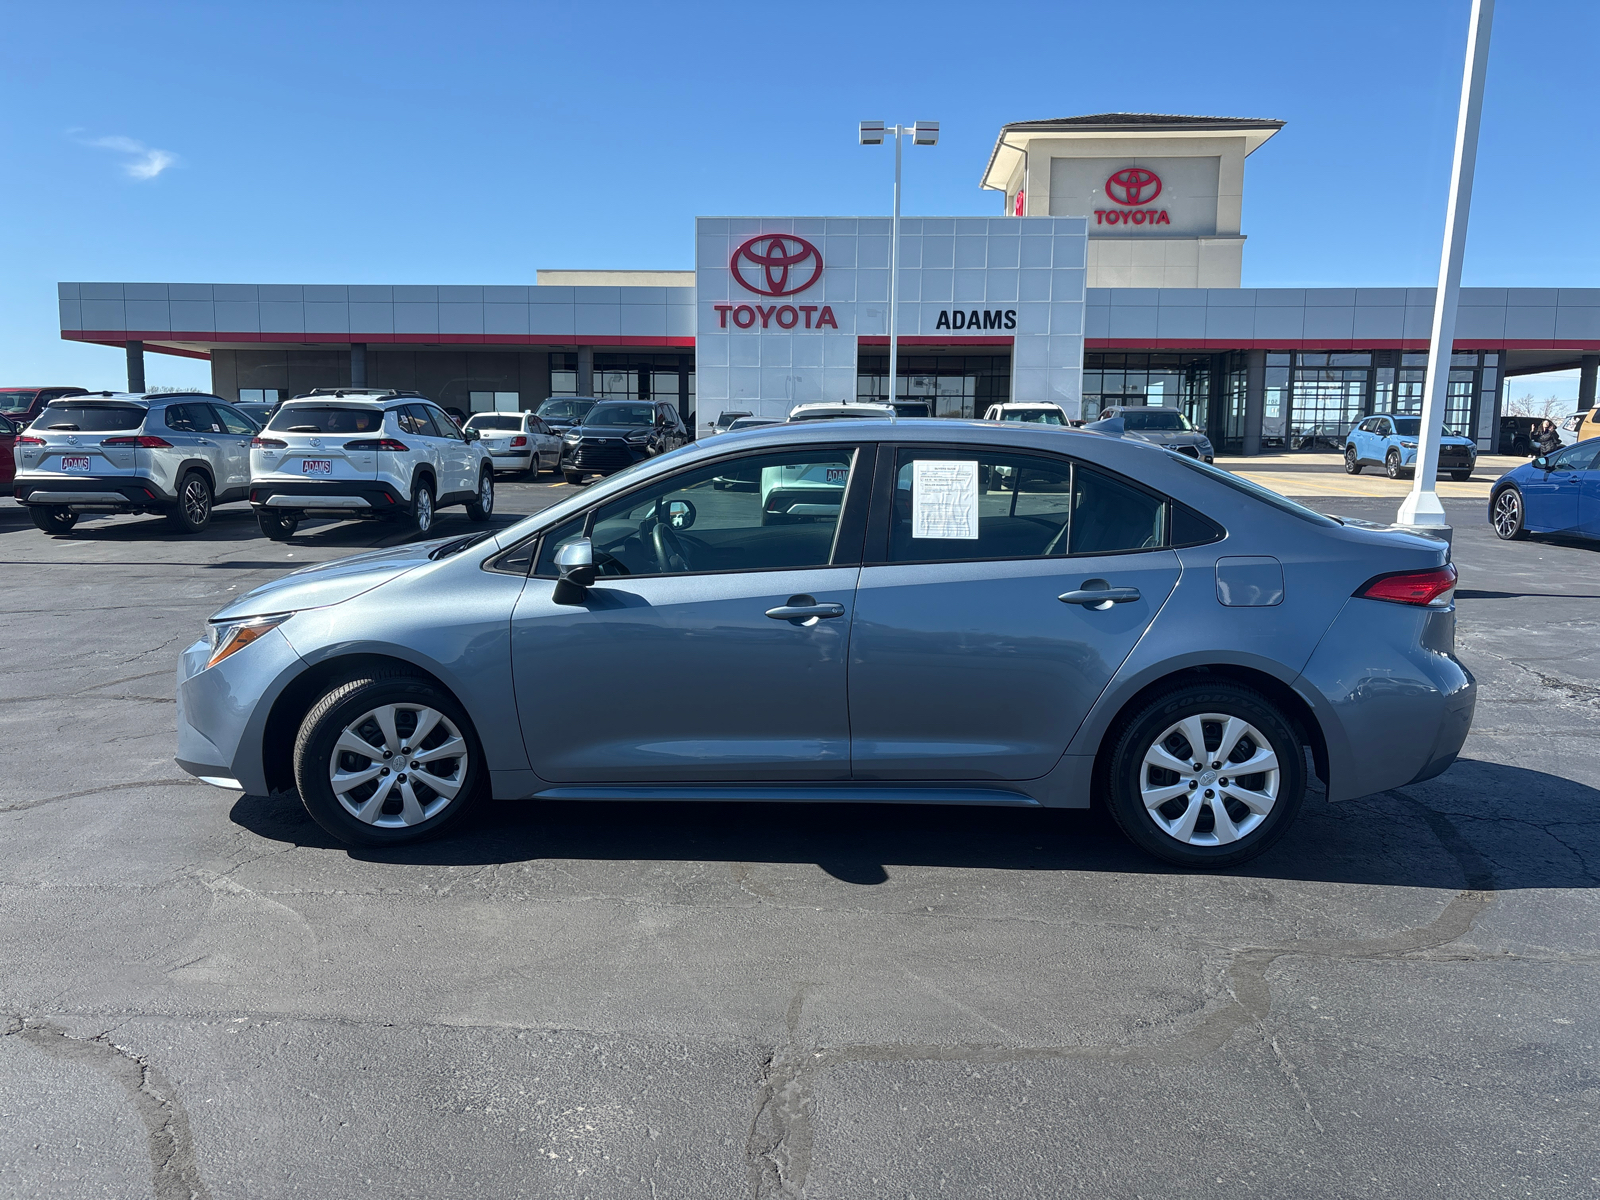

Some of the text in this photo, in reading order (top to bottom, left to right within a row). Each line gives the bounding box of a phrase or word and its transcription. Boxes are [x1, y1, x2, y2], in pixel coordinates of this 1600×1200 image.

[1094, 210, 1170, 225] TOYOTA
[714, 305, 838, 329] TOYOTA
[936, 310, 1017, 330] ADAMS
[63, 458, 88, 469] ADAMS
[303, 461, 330, 472] ADAMS
[827, 470, 848, 481] ADAM
[1164, 694, 1289, 740] GOODYEAR
